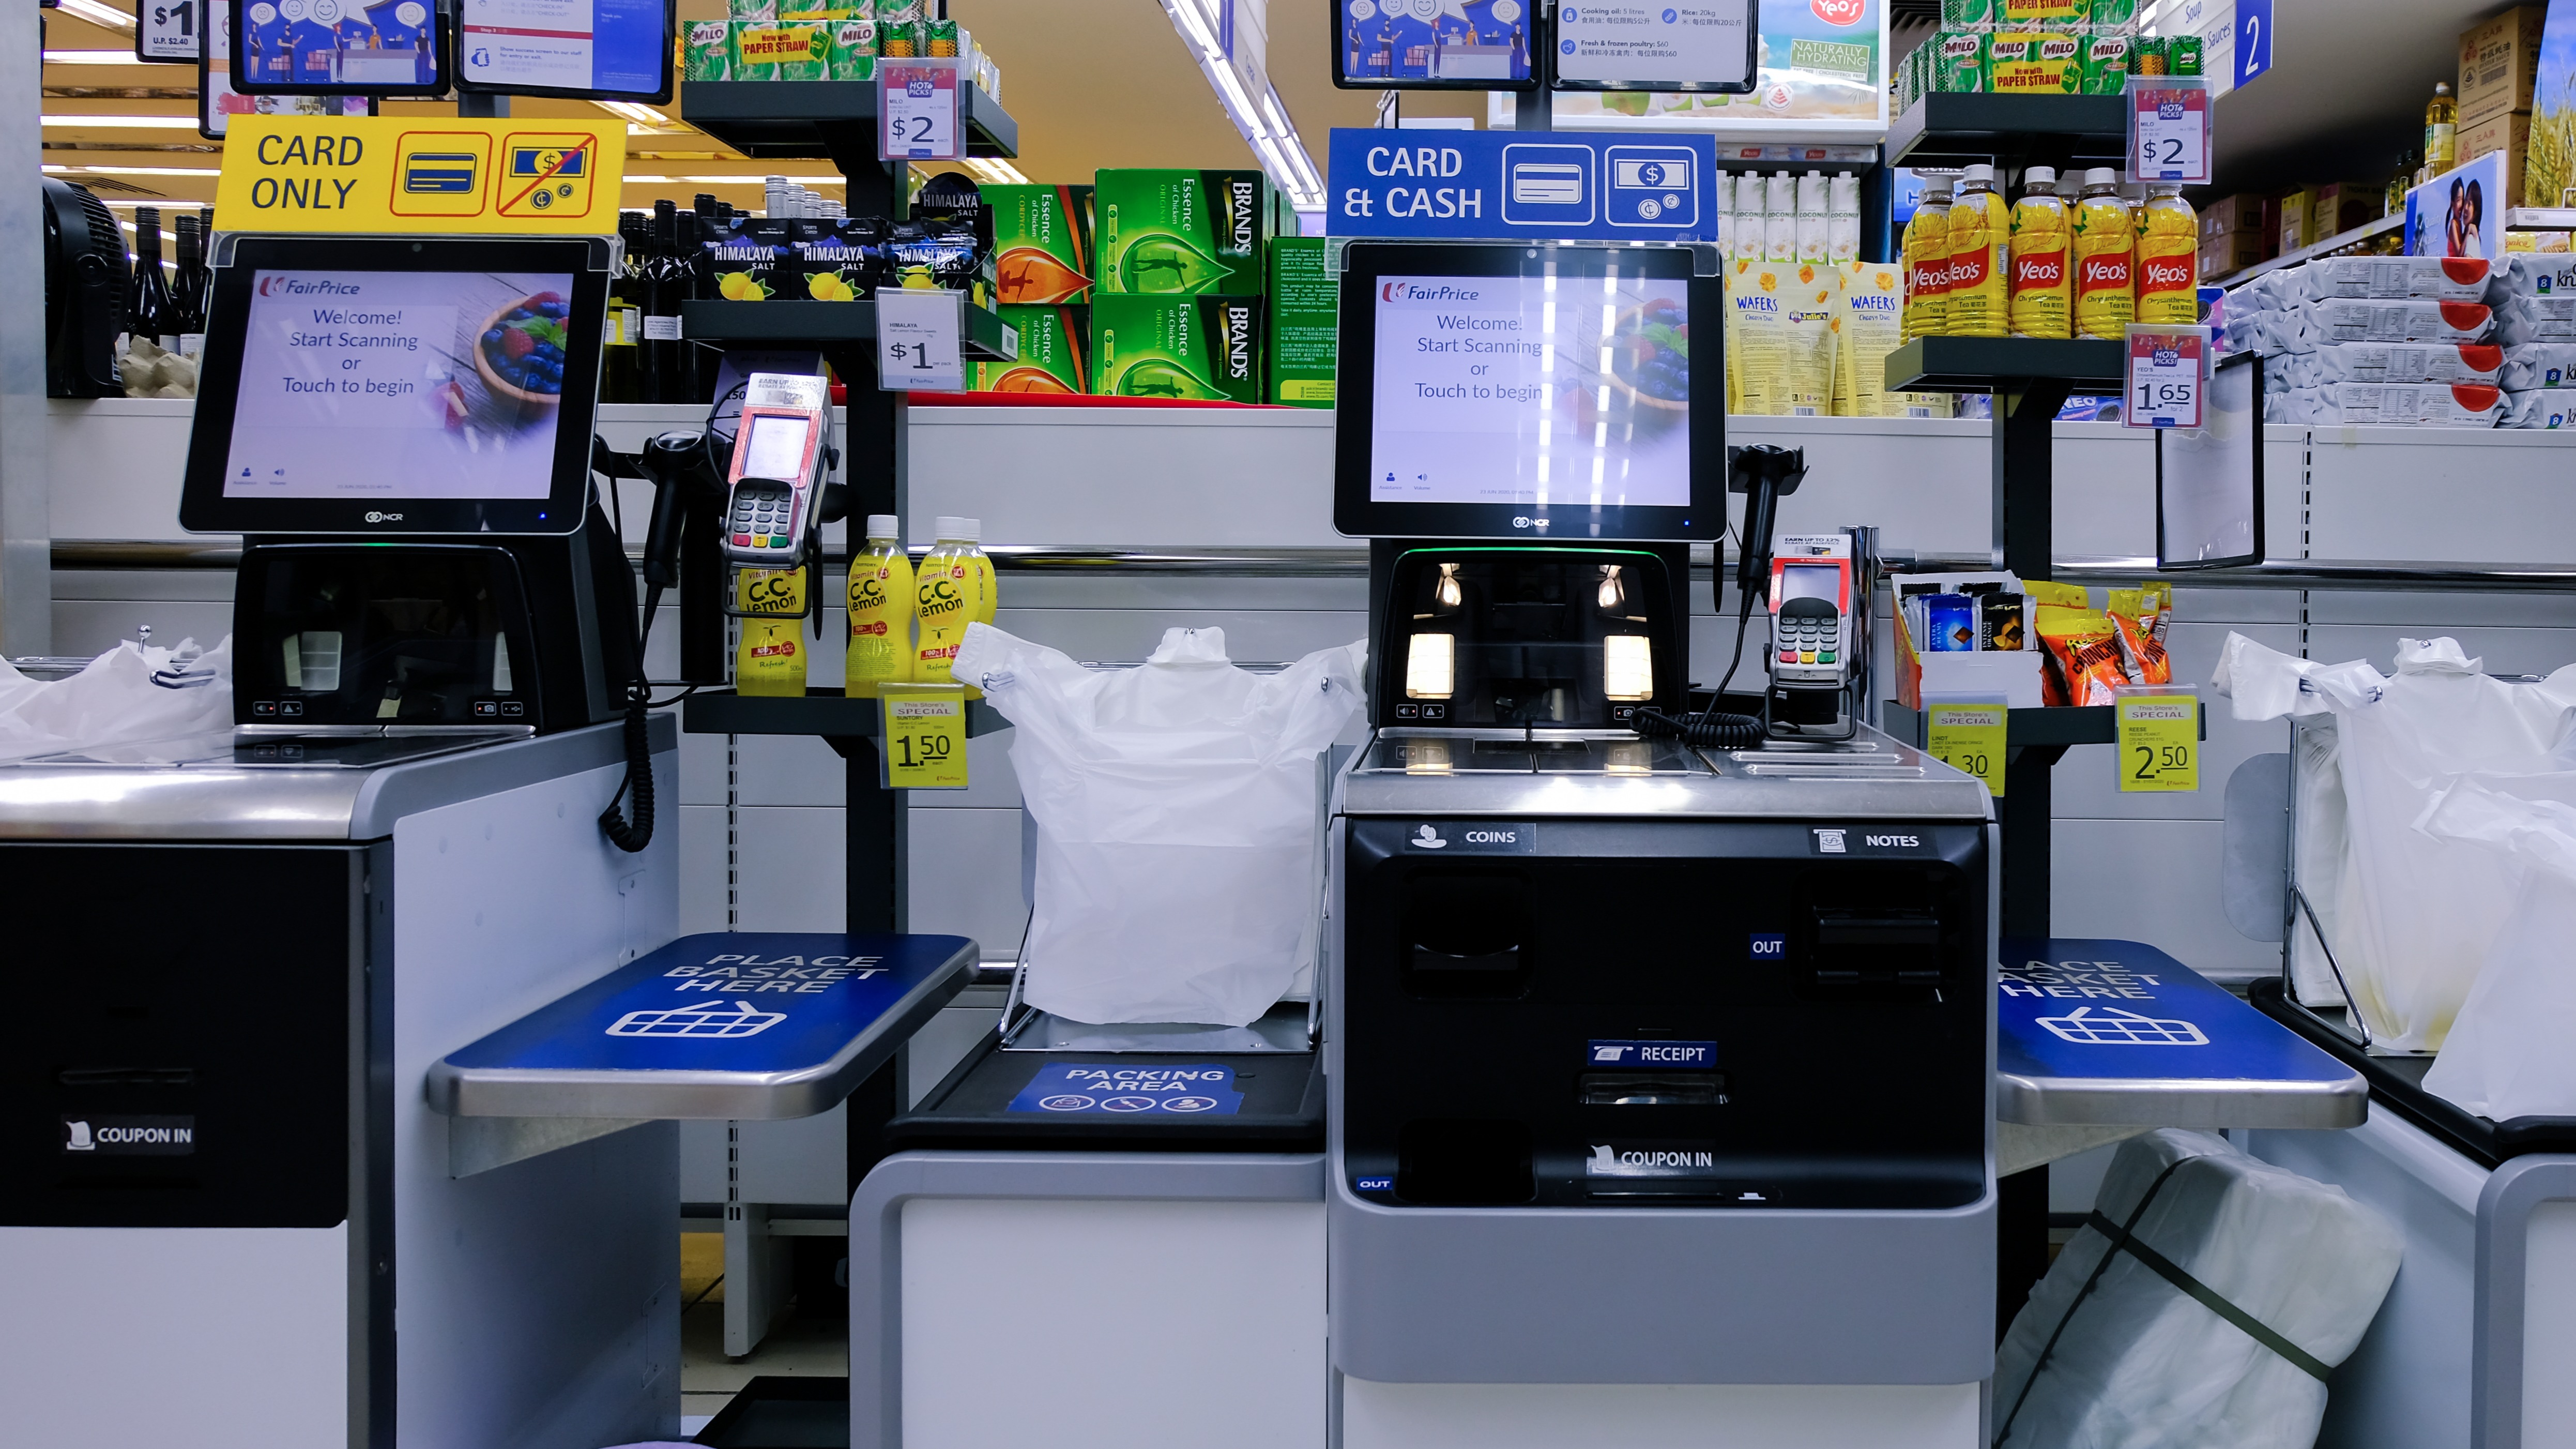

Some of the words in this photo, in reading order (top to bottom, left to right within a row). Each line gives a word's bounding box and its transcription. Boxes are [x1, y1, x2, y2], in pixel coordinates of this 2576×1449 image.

[2186, 2, 2202, 24] Soup
[842, 28, 872, 42] MILO
[2207, 22, 2231, 50] Sauces
[744, 42, 773, 54] PAPER
[776, 40, 809, 52] STRAW
[1793, 41, 1862, 57] NATURALLY
[1945, 41, 1976, 53] MILO
[2093, 43, 2124, 56] MILO
[2246, 15, 2259, 76] 2
[1797, 51, 1867, 66] HYDRATING
[1997, 76, 2026, 87] PAPER
[2029, 74, 2060, 86] STRAW
[257, 134, 363, 166] CARD
[1366, 146, 1462, 177] CARD
[251, 177, 358, 209] ONLY
[923, 194, 978, 208] HIMALAYA
[1183, 179, 1195, 231] Essence
[1344, 187, 1373, 217] &
[1386, 187, 1482, 218] CASH
[1233, 183, 1252, 253] BRAND'S
[715, 247, 775, 261] HIMALAYA
[804, 247, 864, 261] HIMALAYA
[2019, 261, 2059, 282] Yeo's
[2147, 264, 2187, 284] Yeo's
[285, 280, 360, 295] FairPrice
[2540, 278, 2548, 288] 8
[1408, 285, 1478, 301] FairPrice
[1737, 296, 1778, 311] WAFERS
[1851, 295, 1895, 311] WAFERS
[313, 309, 402, 325] Welcome!
[1437, 314, 1522, 331] Welcome!
[1802, 312, 1827, 321] Julie's
[1179, 304, 1191, 356] Essence
[289, 333, 332, 347] Start
[338, 333, 418, 351] Scanning
[1043, 314, 1054, 364] Essence
[1229, 307, 1248, 378] BRAND'S
[1417, 337, 1458, 353] Start
[1464, 337, 1542, 356] Scanning
[342, 357, 361, 370] or
[1470, 363, 1488, 375] or
[283, 378, 335, 394] Touch
[342, 380, 359, 394] to
[365, 378, 414, 396] begin
[1415, 382, 1466, 399] Touch
[1472, 383, 1490, 399] to
[1496, 382, 1543, 402] begin
[2138, 384, 2191, 410] 1.65
[749, 578, 791, 602] C.C.
[850, 579, 881, 600] C.C.
[919, 581, 956, 605] C.C.
[897, 735, 950, 767] 1.50
[2136, 746, 2188, 779] 2.50
[1466, 831, 1516, 844] COINS
[1866, 834, 1919, 848] NOTES
[1752, 940, 1782, 954] OUT
[706, 955, 883, 966] PLACE
[1998, 961, 2131, 972] LACE
[663, 966, 889, 979] BASKET
[1998, 973, 2160, 986] ASKET
[675, 979, 835, 993] HERE
[2000, 985, 2156, 999] HERE
[1641, 1047, 1705, 1062] RECEIPT
[1065, 1069, 1225, 1081] PACKING
[1087, 1081, 1187, 1091] AREA
[97, 1127, 170, 1143] COUPON
[174, 1128, 192, 1143] IN
[1621, 1152, 1690, 1167] COUPON
[1695, 1152, 1713, 1167] IN
[1360, 1180, 1390, 1189] OUT
